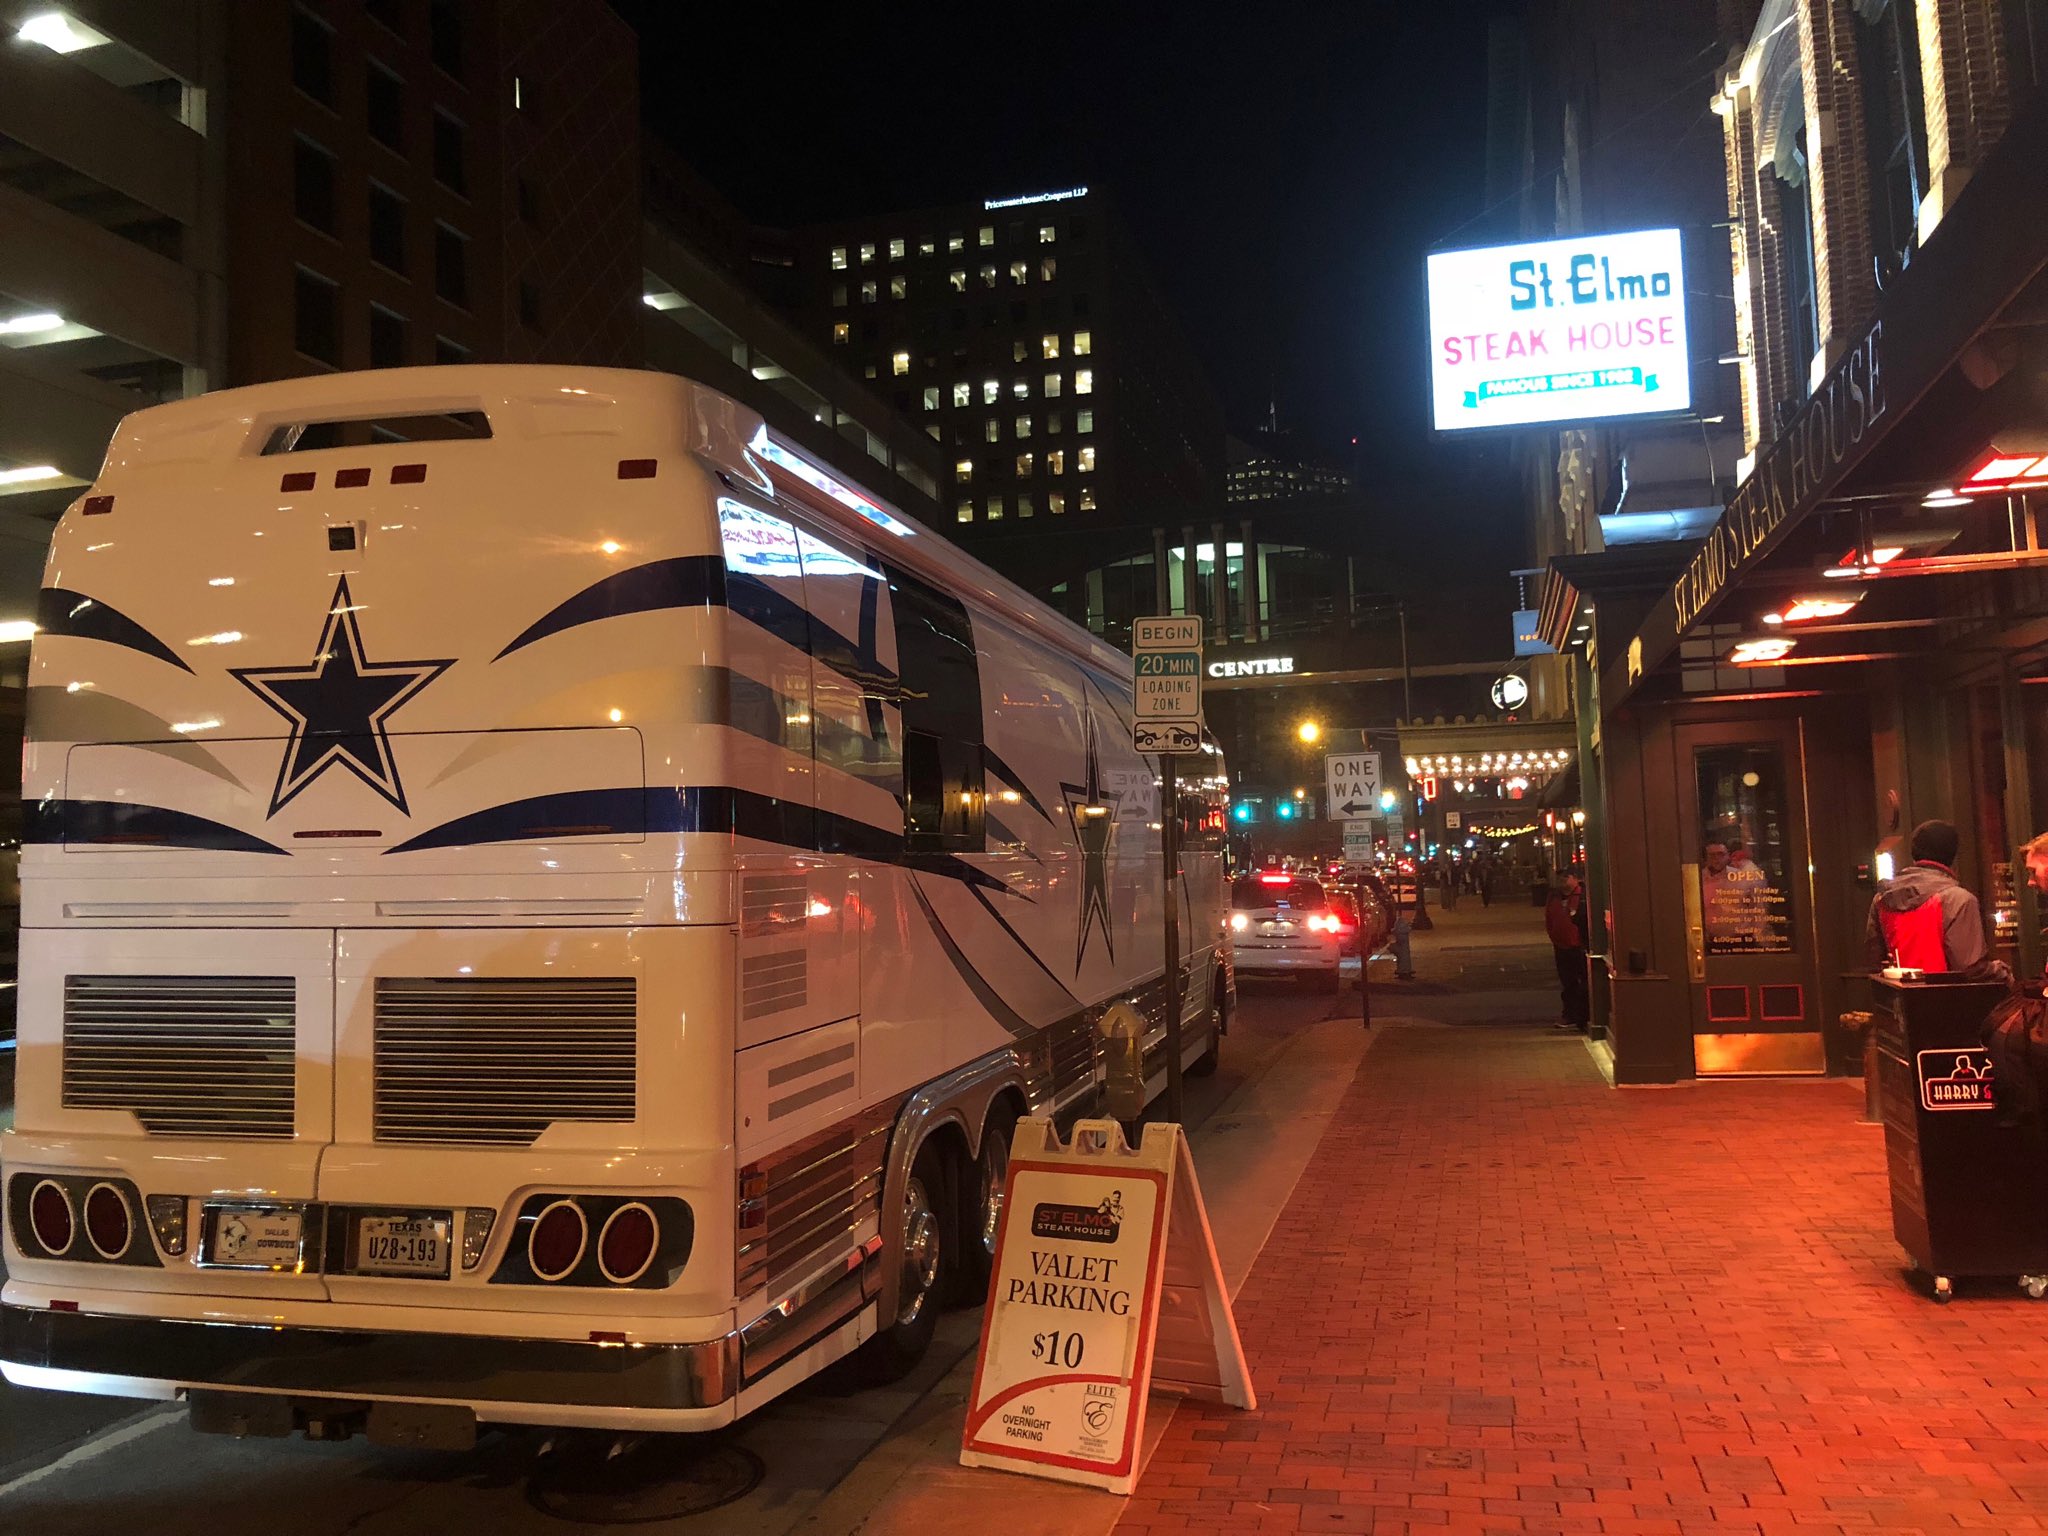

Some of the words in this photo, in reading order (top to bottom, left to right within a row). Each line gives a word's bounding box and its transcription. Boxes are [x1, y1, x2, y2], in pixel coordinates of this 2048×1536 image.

[1073, 187, 1088, 197] LLP
[1510, 259, 1564, 311] St.
[1566, 253, 1671, 305] Elmo
[1443, 328, 1549, 366] STEAK
[1568, 316, 1675, 351] HOUSE
[1691, 525, 1726, 617] ELMO
[1727, 447, 1788, 570] STEAK
[1788, 319, 1886, 510] HOUSE
[1142, 626, 1194, 640] BEGIN
[1141, 655, 1164, 674] 20
[1169, 659, 1194, 673] MIN
[1208, 657, 1294, 678] CENTRE
[1142, 680, 1192, 693] LOADING
[1152, 697, 1181, 711] ZONE
[1334, 760, 1374, 777] ONE
[1333, 781, 1376, 798] WAY
[1727, 870, 1765, 881] OPEN
[1754, 887, 1779, 895] Friday
[1934, 1084, 1979, 1100] HARRY
[1061, 1211, 1113, 1227] ELMO
[264, 1228, 289, 1237] DALLAS
[388, 1223, 422, 1233] TEXAS
[1037, 1223, 1072, 1233] STEAK
[1073, 1226, 1111, 1236] HOUSE
[257, 1239, 296, 1248] COWBOYS
[1029, 1251, 1118, 1283] VALET
[1008, 1279, 1130, 1316] PARKING
[1031, 1330, 1084, 1368] $10
[1086, 1384, 1117, 1397] ELITE
[1021, 1405, 1035, 1416] NO
[1002, 1414, 1051, 1430] OVERNIGHT
[1006, 1426, 1043, 1441] PARKING
